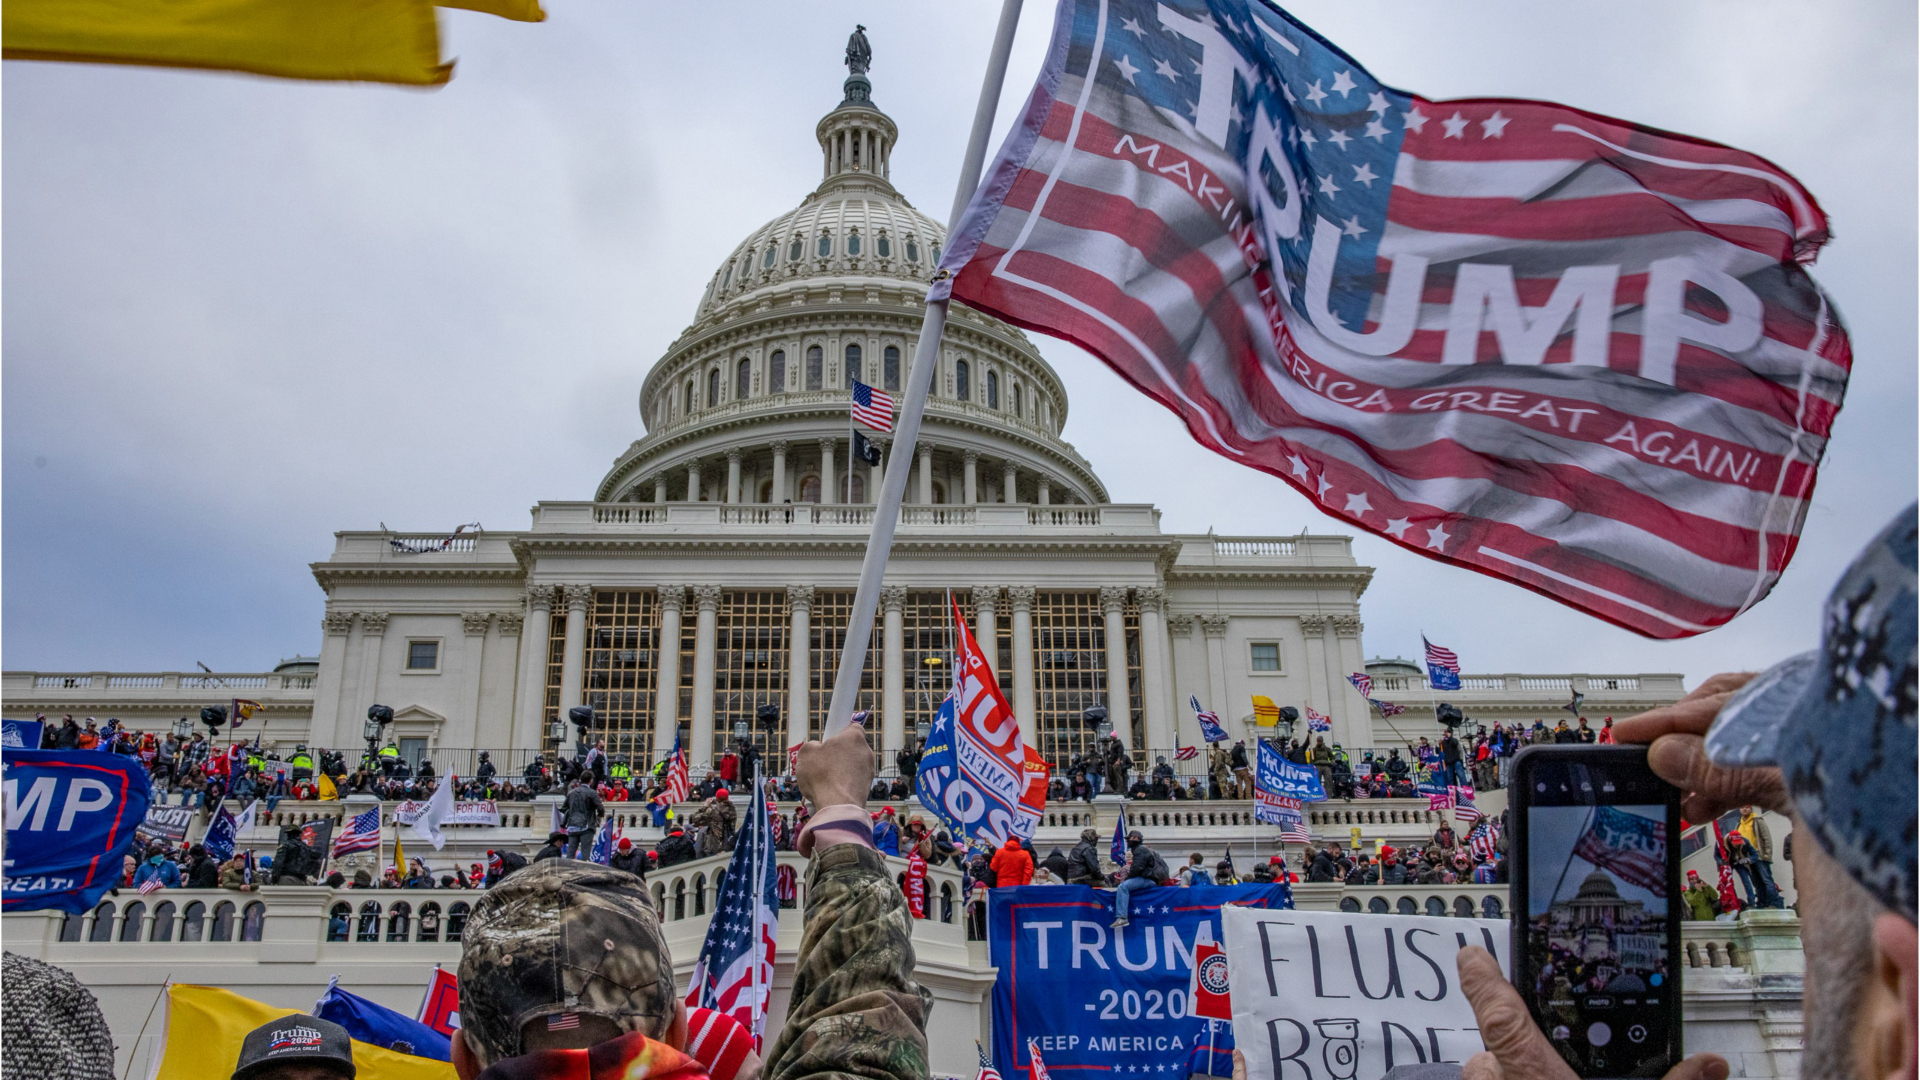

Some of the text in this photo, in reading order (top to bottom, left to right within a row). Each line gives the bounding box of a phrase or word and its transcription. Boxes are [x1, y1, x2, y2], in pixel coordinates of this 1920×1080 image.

[1157, 2, 1765, 386] TRUMP
[1408, 391, 1600, 433] GREAT
[1604, 420, 1761, 483] AGAIN!
[1264, 769, 1311, 793] 2024
[456, 804, 473, 813] FOR
[1022, 919, 1214, 972] TRUM
[271, 1029, 322, 1043] Trump
[1027, 1035, 1080, 1051] KEEP
[1087, 1035, 1184, 1052] AMERICA
